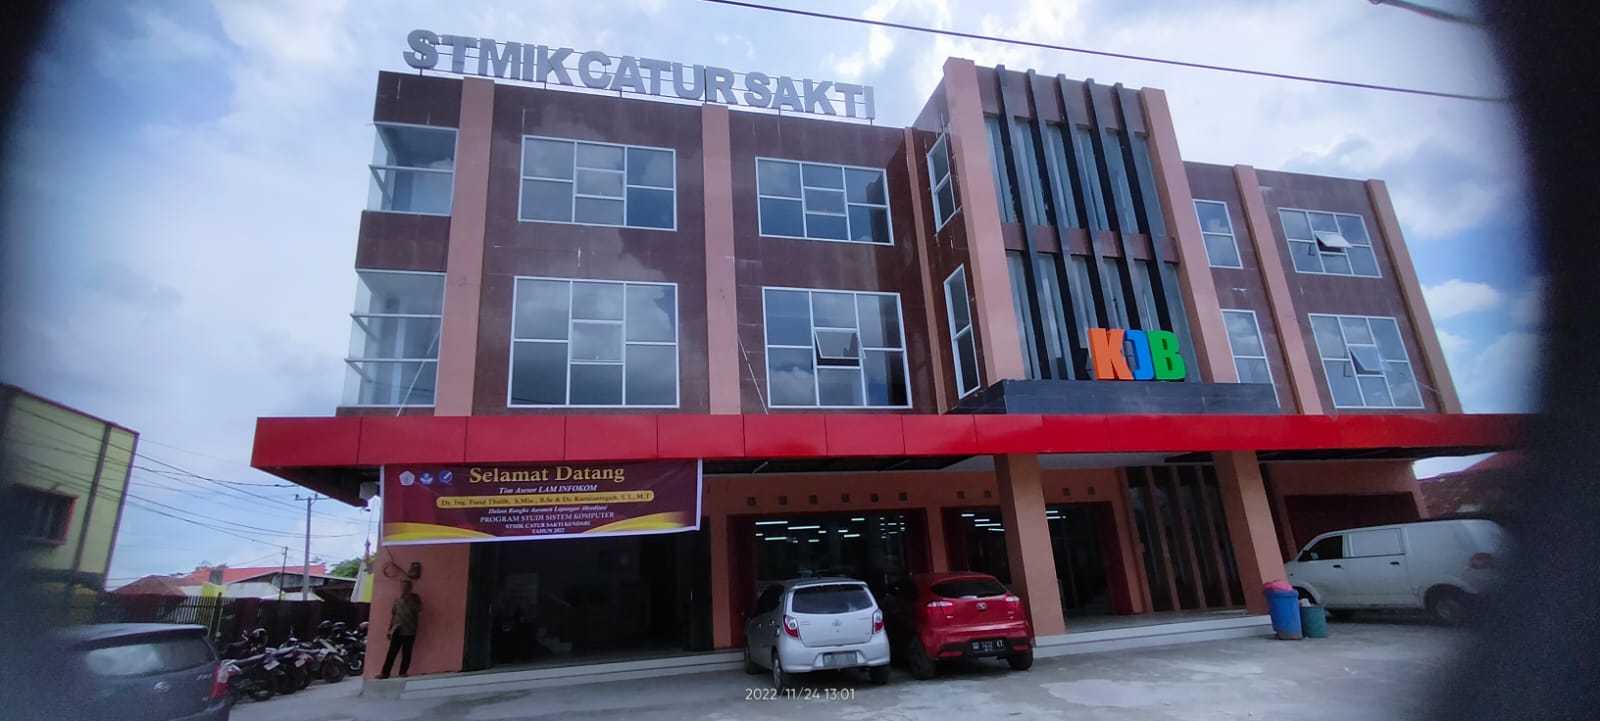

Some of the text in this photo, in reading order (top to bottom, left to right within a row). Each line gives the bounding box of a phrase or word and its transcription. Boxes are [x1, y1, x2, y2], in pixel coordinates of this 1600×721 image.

[403, 29, 875, 119] STMIK CATUR SAKTI
[470, 466, 625, 482] Selamat Datang
[538, 485, 557, 493] LAM
[558, 484, 597, 492] INFOKOM
[545, 513, 572, 521] SISTEM
